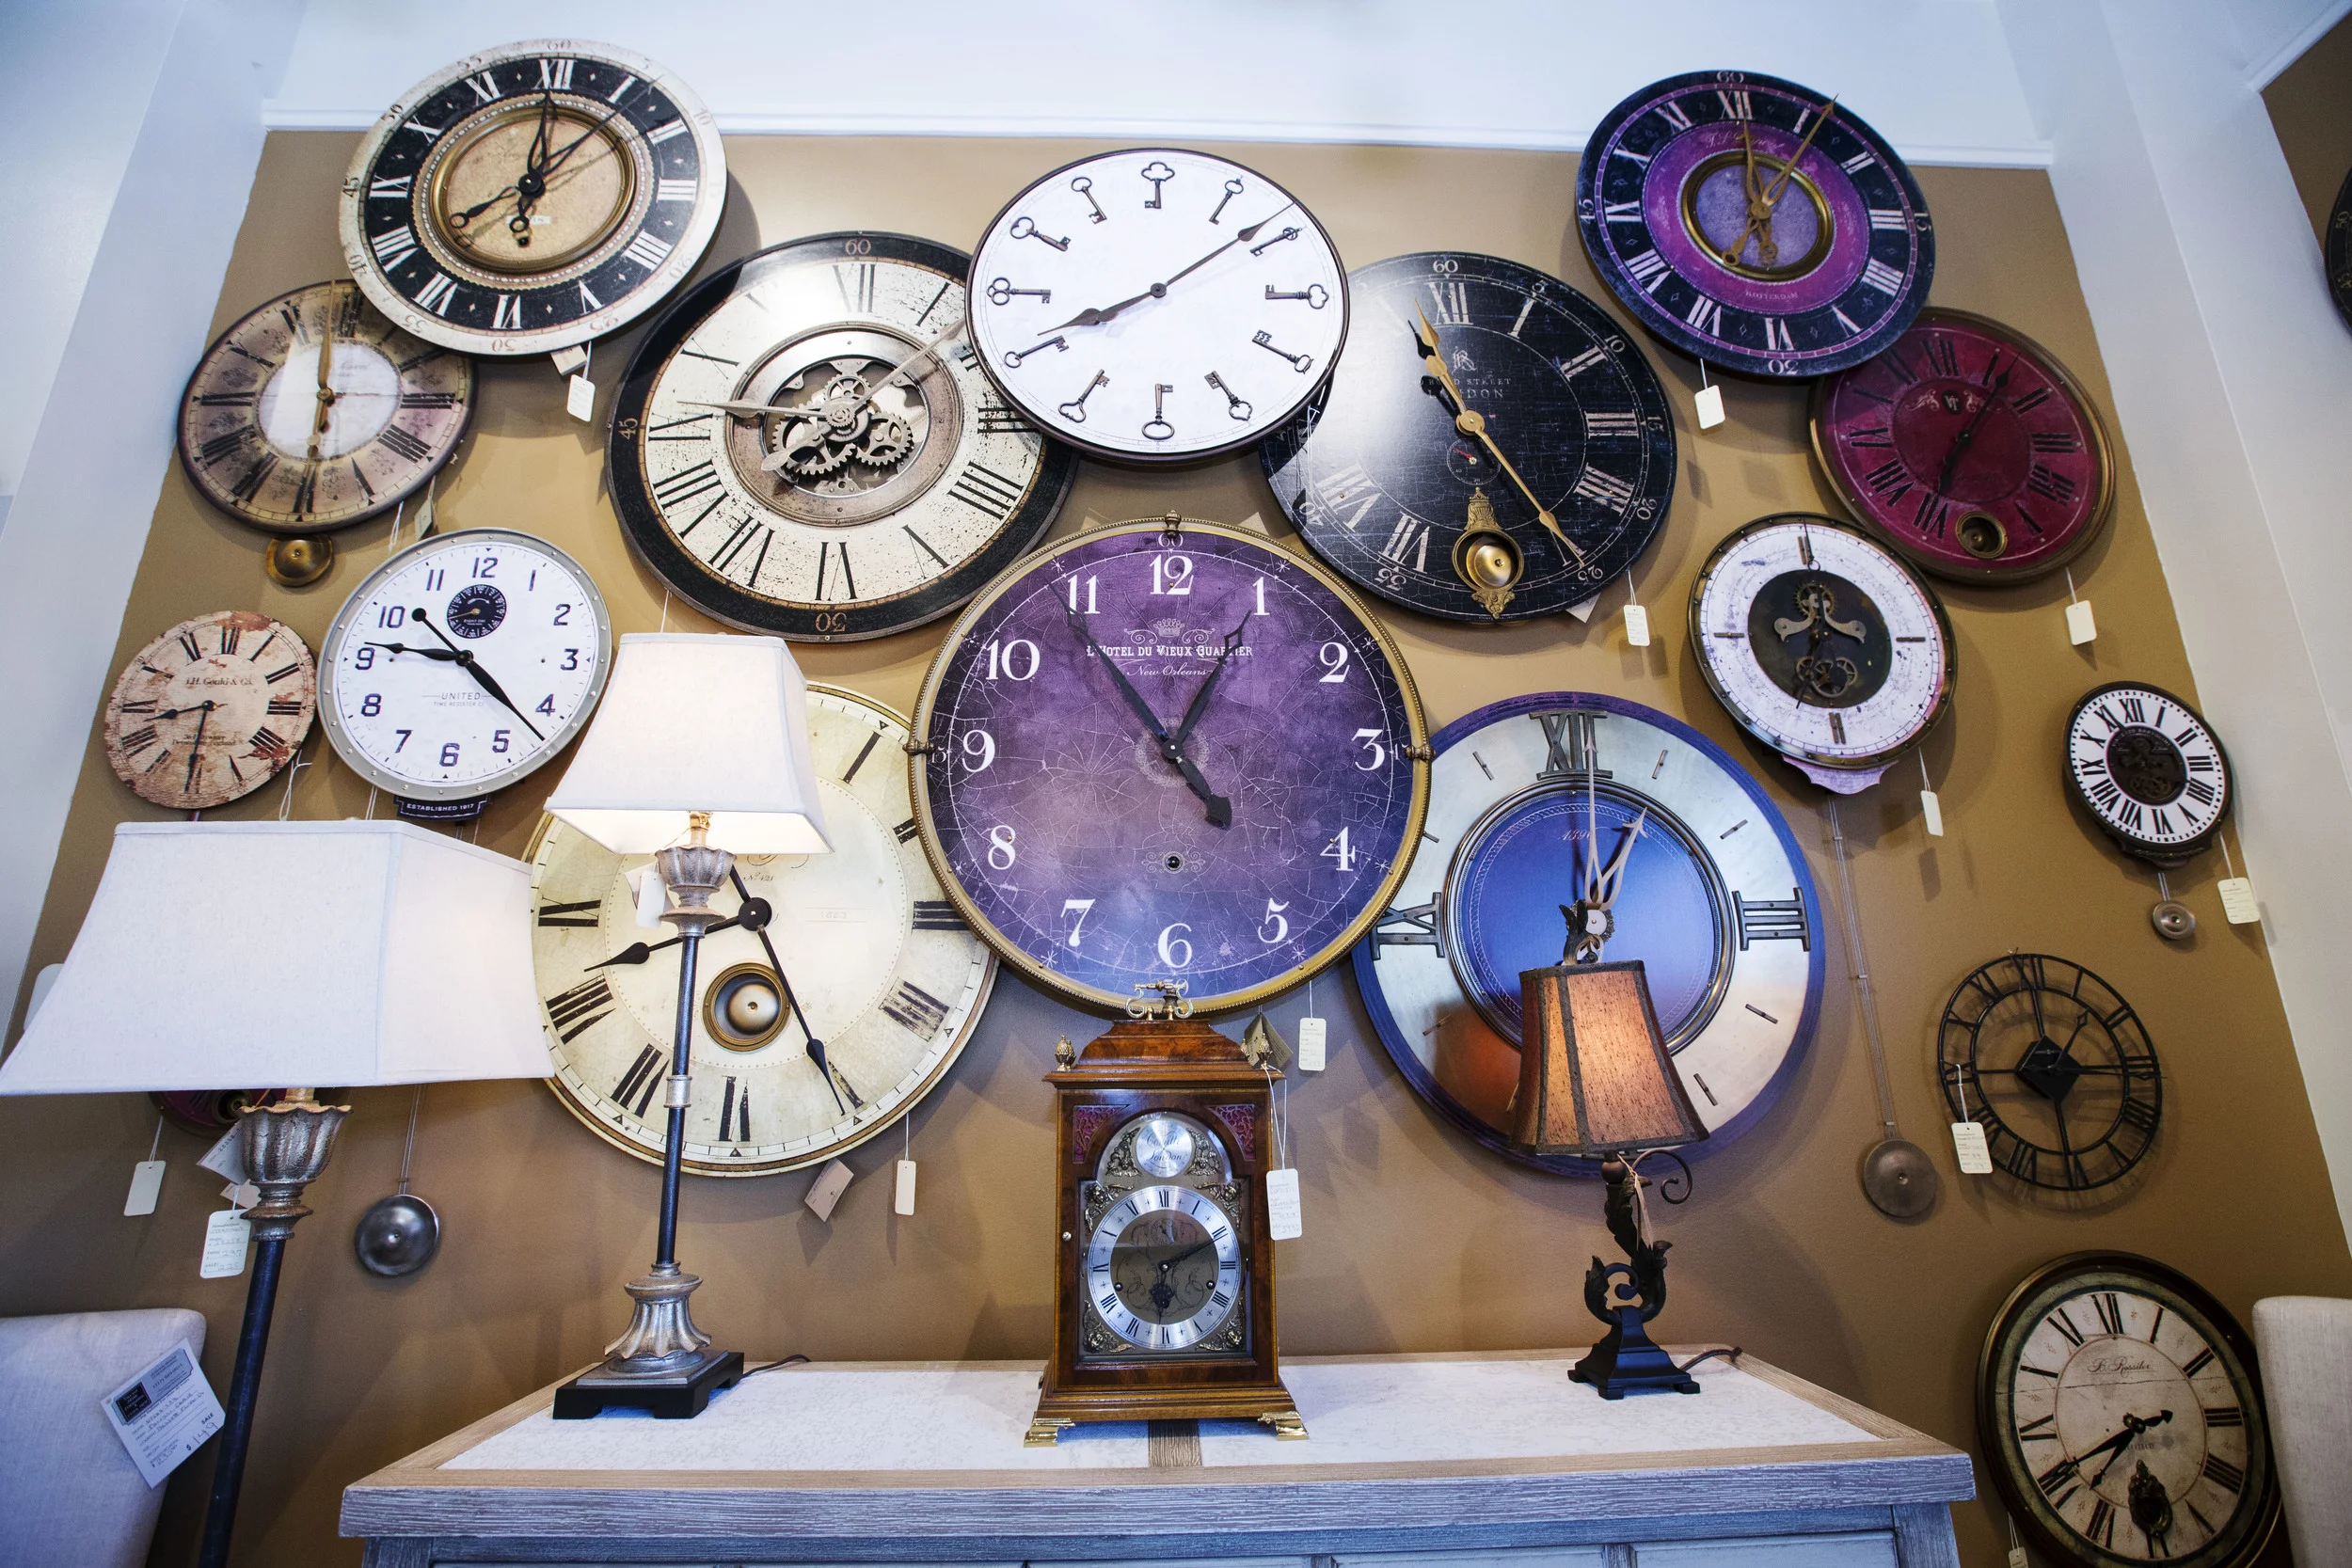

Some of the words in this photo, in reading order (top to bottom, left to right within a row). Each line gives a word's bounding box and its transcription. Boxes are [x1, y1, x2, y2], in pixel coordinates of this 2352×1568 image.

[466, 70, 501, 103] XI
[532, 58, 578, 89] XII
[1716, 71, 1745, 84] 60
[1655, 100, 1693, 135] XI
[1716, 90, 1754, 120] XII
[404, 115, 444, 144] X
[646, 118, 689, 146] II
[1613, 144, 1651, 172] X
[1841, 151, 1876, 174] II
[369, 174, 412, 198] IX
[657, 178, 696, 202] III
[1580, 198, 1595, 222] 45
[1604, 197, 1642, 223] IX
[1869, 209, 1908, 230] III
[371, 226, 421, 273] VIII
[622, 229, 675, 272] IIII
[845, 239, 872, 255] 60
[1433, 260, 1459, 273] 60
[1625, 248, 1673, 294] VIII
[1860, 257, 1905, 297] IIII
[412, 272, 459, 316] VII
[580, 279, 604, 313] V
[1423, 281, 1474, 326] XII
[492, 294, 523, 329] VI
[1508, 291, 1537, 340] I
[1685, 294, 1722, 338] VII
[1606, 334, 1626, 354] 10
[1764, 317, 1796, 351] VI
[680, 337, 740, 380] X
[1559, 345, 1611, 381] II
[1768, 359, 1799, 375] 30
[399, 392, 455, 409] III
[1429, 388, 1503, 399] LDON
[2013, 388, 2050, 415] II
[623, 417, 639, 438] 45
[647, 411, 714, 442] IX
[1584, 408, 1640, 439] III
[1646, 414, 1664, 433] 15
[376, 423, 433, 464] IIII
[2031, 433, 2076, 452] III
[948, 461, 1025, 521] IIII
[1573, 462, 1637, 517] IIII
[1866, 458, 1915, 507] VIII
[652, 459, 729, 537] VIII
[1317, 462, 1382, 532] VIII
[1636, 499, 1657, 521] 20
[707, 515, 775, 588] VII
[901, 524, 950, 578] V
[1157, 532, 1183, 549] 60
[1377, 512, 1430, 574] VII
[426, 569, 444, 591] 11
[472, 557, 498, 578] 12
[529, 570, 536, 591] 1
[815, 540, 858, 601] VI
[1150, 555, 1194, 595] 12
[1067, 577, 1101, 614] 11
[1251, 577, 1271, 616] 1
[378, 606, 405, 628] 10
[553, 604, 571, 626] 2
[815, 611, 848, 633] 30
[355, 647, 375, 671] 9
[561, 648, 580, 671] 3
[986, 639, 1041, 681] 10
[1087, 646, 1134, 656] LHOTEL
[1138, 646, 1152, 656] DU
[1156, 645, 1192, 657] VIEUX
[1319, 641, 1350, 683] 2
[265, 662, 302, 685] II
[1127, 665, 1158, 675] New
[1162, 662, 1213, 675] Orleans
[266, 700, 302, 716] III
[360, 693, 382, 717] 8
[535, 694, 555, 717] 4
[2119, 698, 2145, 723] XII
[394, 729, 413, 753] 7
[492, 730, 510, 752] 5
[961, 730, 995, 772] 9
[1351, 728, 1385, 771] 3
[1530, 710, 1613, 781] XII
[2080, 730, 2106, 748] X
[2174, 728, 2199, 747] II
[439, 743, 460, 767] 6
[2079, 758, 2106, 775] IX
[2185, 755, 2214, 771] III
[2090, 778, 2122, 812] VIII
[2118, 799, 2142, 830] VII
[2152, 809, 2174, 834] VI
[987, 825, 1017, 870] 8
[1320, 826, 1357, 871] 4
[538, 896, 601, 927] IX
[1060, 898, 1096, 947] 7
[1257, 897, 1290, 943] 5
[1732, 887, 1811, 952] III
[1371, 892, 1445, 960] IX
[1157, 923, 1193, 969] 6
[545, 973, 616, 1045] VIII
[611, 1044, 670, 1117] VII
[719, 1075, 751, 1142] VI
[1159, 1190, 1168, 1208] XII
[1220, 1260, 1236, 1270] III
[1101, 1293, 1118, 1314] VIII
[1212, 1291, 1229, 1307] IIII
[1126, 1317, 1140, 1338] VII
[1163, 1326, 1170, 1344] VI
[2183, 1347, 2215, 1378] II
[201, 1413, 215, 1424] SALE
[194, 1422, 218, 1444] 149
